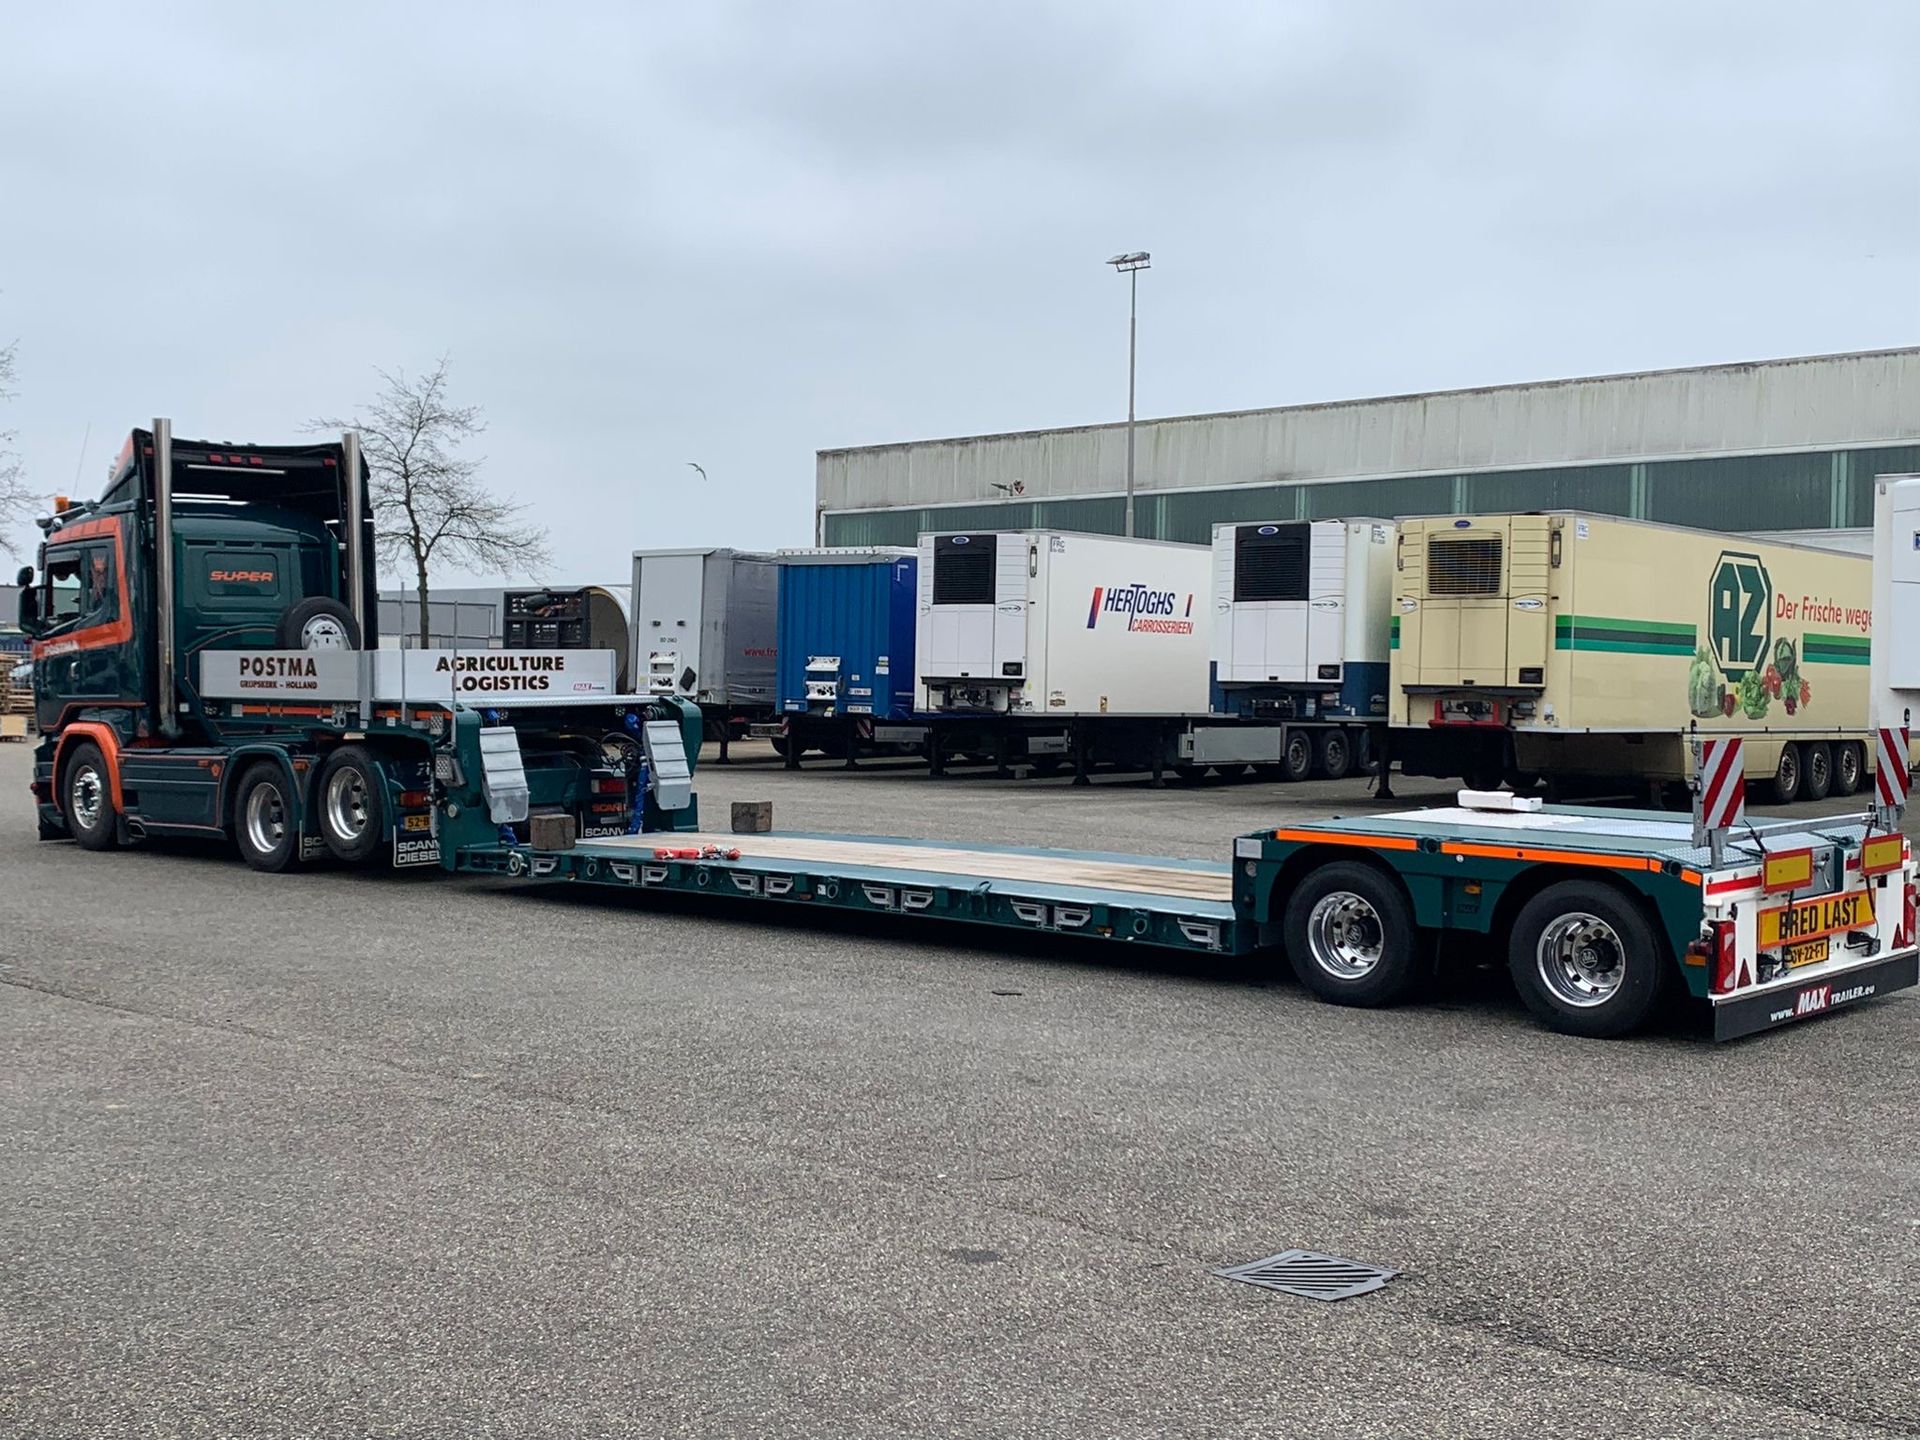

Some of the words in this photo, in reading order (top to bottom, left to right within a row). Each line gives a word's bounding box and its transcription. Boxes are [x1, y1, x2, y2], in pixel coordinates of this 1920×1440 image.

[210, 571, 274, 581] SUPER
[1104, 584, 1175, 632] HERTOGHS
[1713, 562, 1766, 663] AZ
[1776, 593, 1798, 620] Der
[1801, 596, 1842, 625] Frische
[1132, 619, 1194, 635] CARROSSERIEEN
[240, 658, 317, 676] POSTMA
[436, 656, 564, 672] AGRICULTURE
[286, 682, 317, 690] HOLLAND
[452, 676, 550, 692] LOGISTICS
[1779, 905, 1818, 940] BRED
[1824, 896, 1860, 931] LAST
[1797, 986, 1828, 1015] MAX
